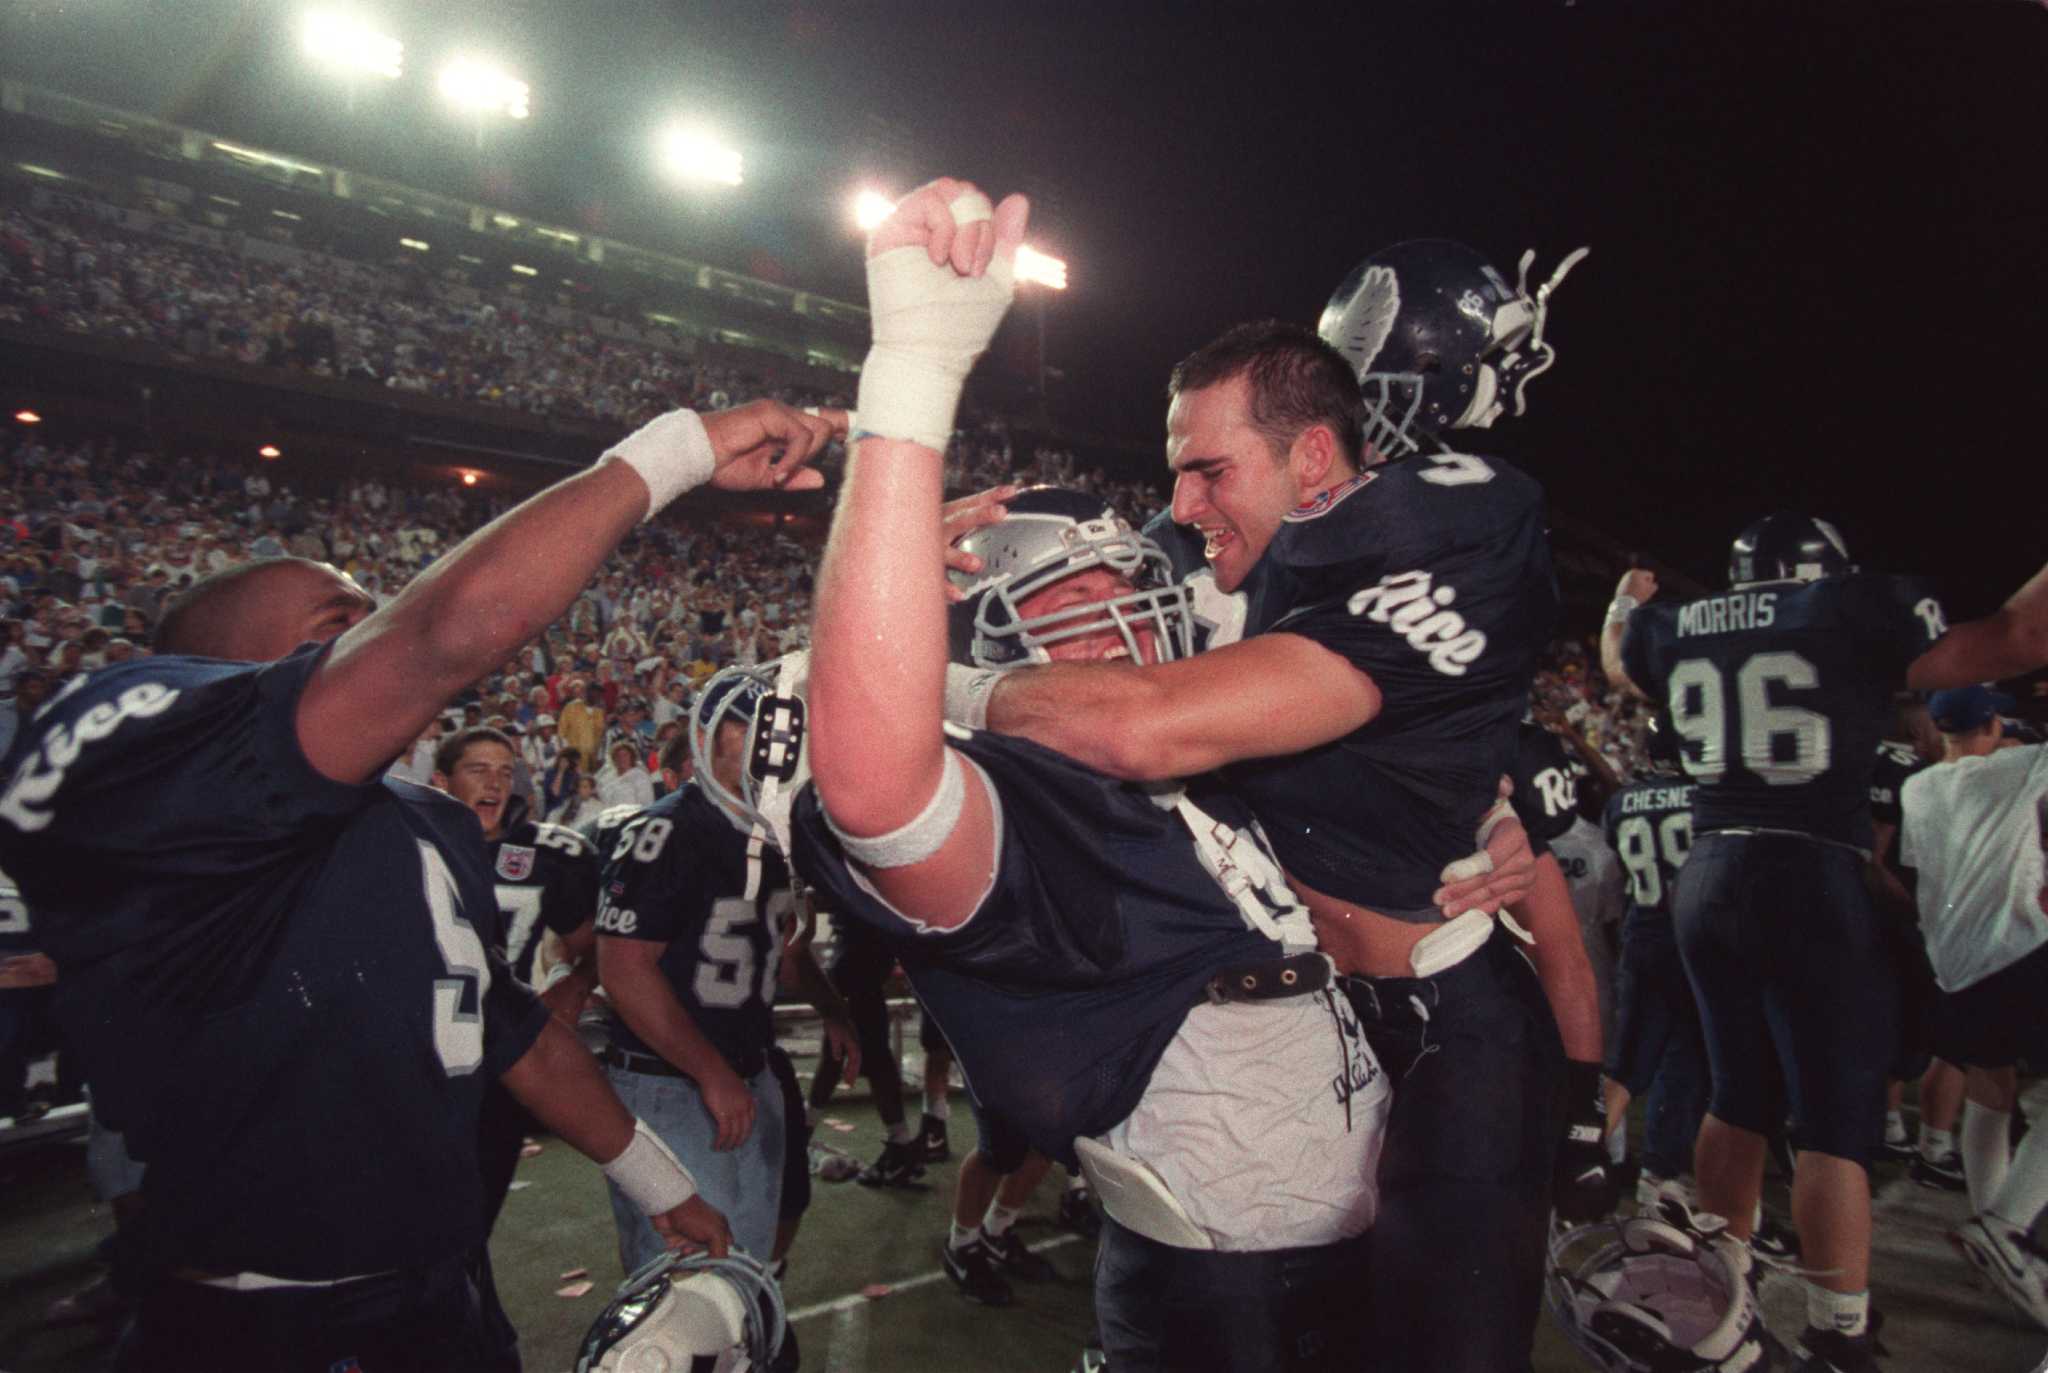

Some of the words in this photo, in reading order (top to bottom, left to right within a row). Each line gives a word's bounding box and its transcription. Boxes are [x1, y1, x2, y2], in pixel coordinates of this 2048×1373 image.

[1347, 569, 1487, 676] Rice
[1677, 592, 1777, 638] MORRIS
[1669, 651, 1831, 785] 96
[1621, 785, 1698, 813] CHESNE
